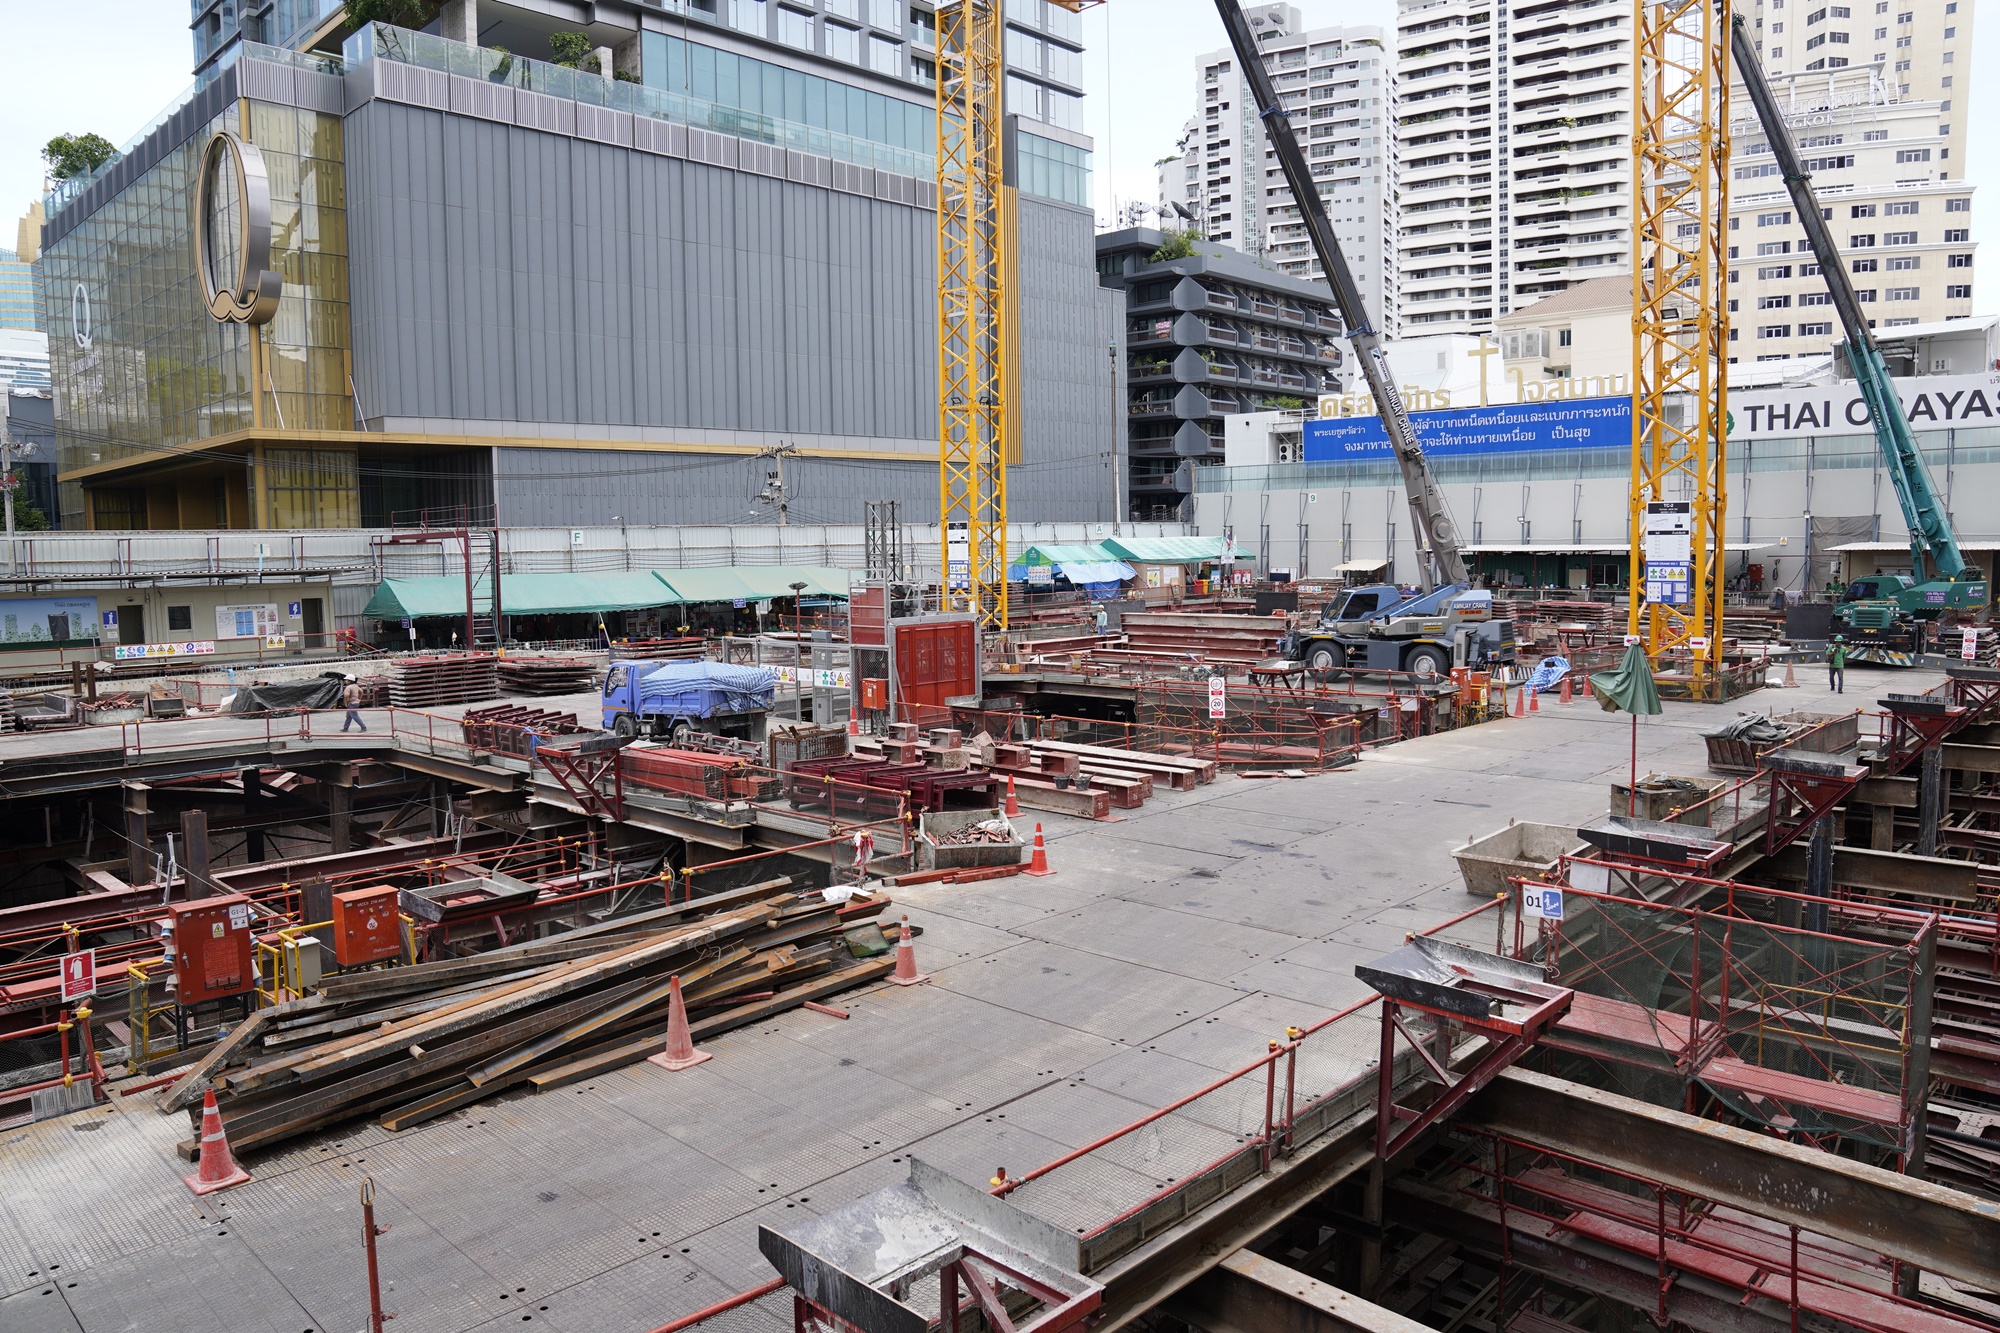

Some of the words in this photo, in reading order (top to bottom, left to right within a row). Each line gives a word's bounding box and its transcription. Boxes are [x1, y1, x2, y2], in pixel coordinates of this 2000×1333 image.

[1507, 367, 1628, 403] ใจสมาน
[1385, 385, 1404, 418] AMNUAY
[1397, 417, 1414, 445] CRANE
[1743, 400, 1831, 432] THAI
[1844, 388, 2000, 426] OAYA
[1551, 425, 1591, 442] เป็นสุข
[1310, 494, 1316, 502] 9
[574, 532, 581, 542] F
[1526, 895, 1542, 908] 01
[230, 907, 245, 916] G1-2
